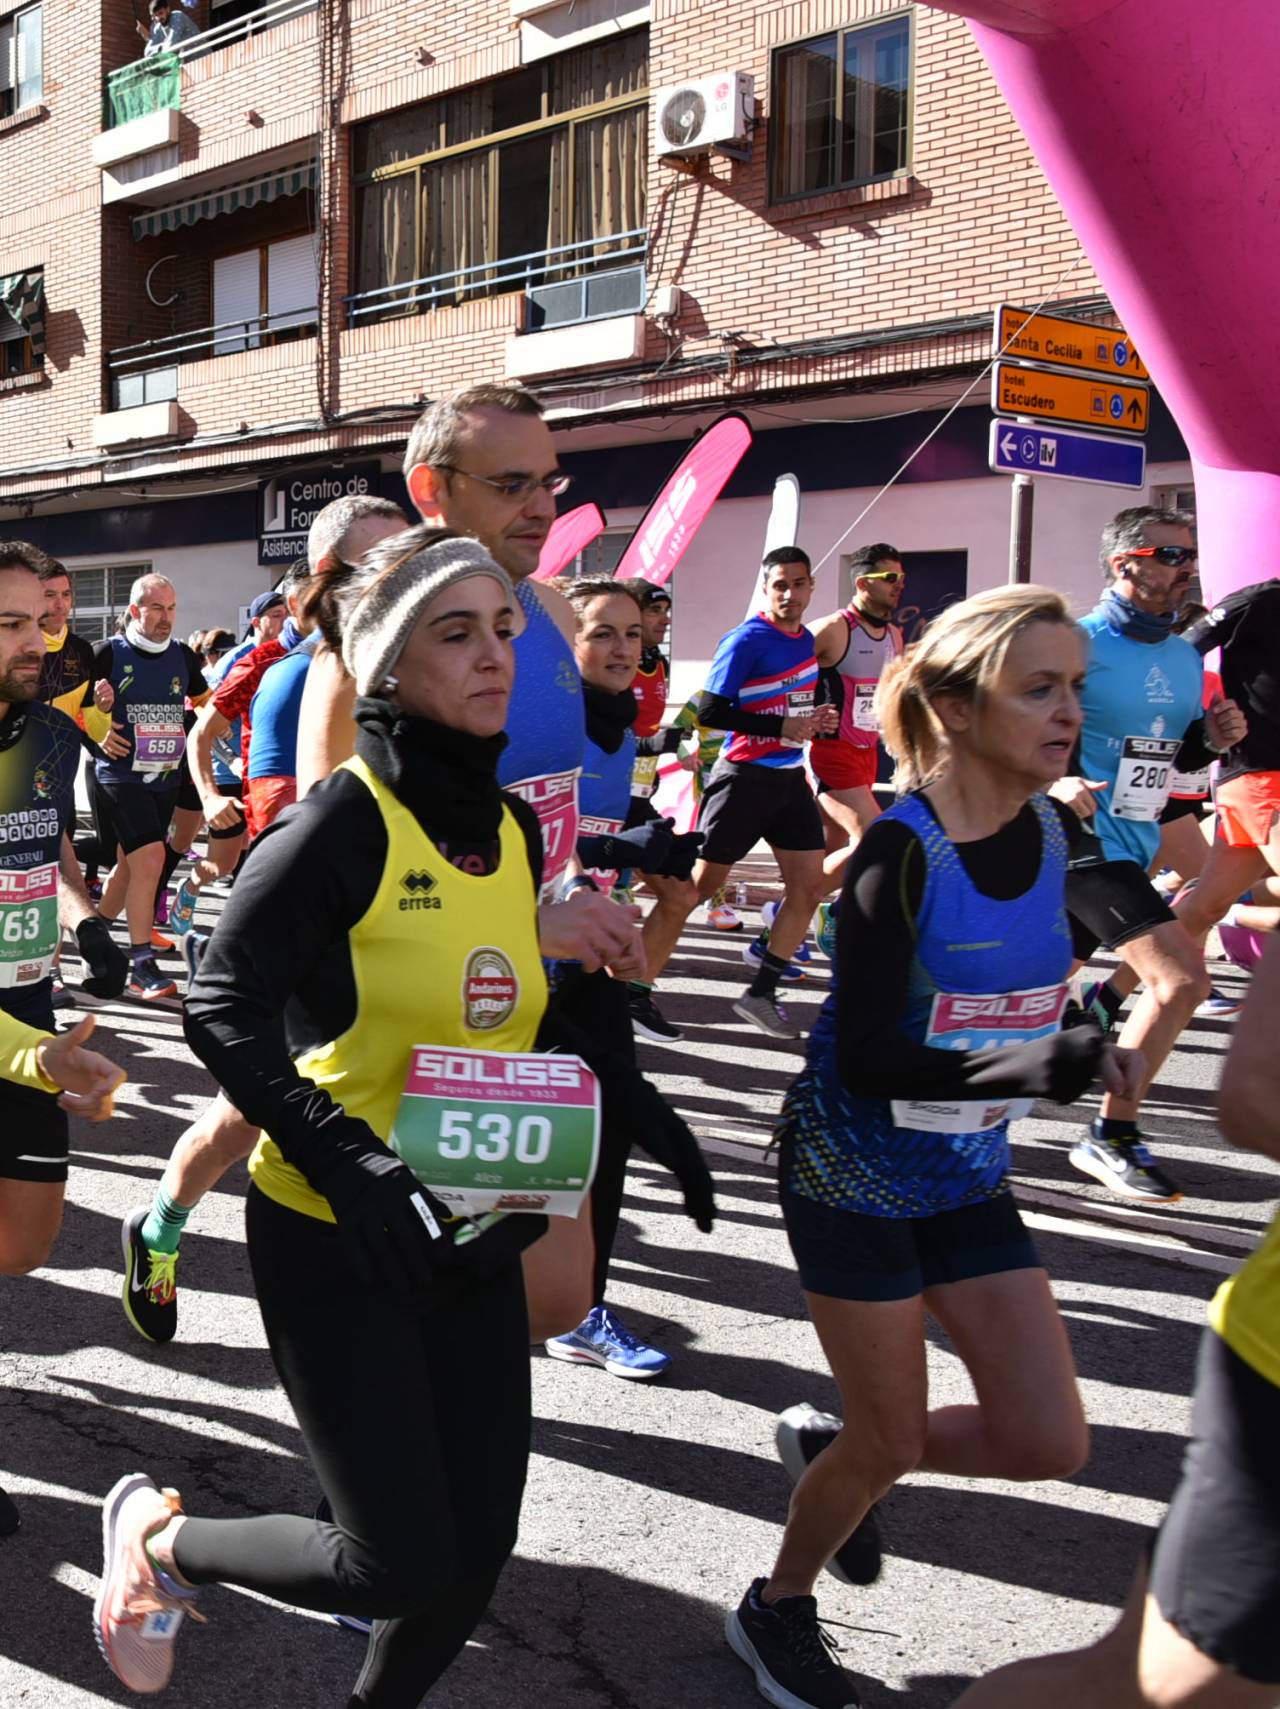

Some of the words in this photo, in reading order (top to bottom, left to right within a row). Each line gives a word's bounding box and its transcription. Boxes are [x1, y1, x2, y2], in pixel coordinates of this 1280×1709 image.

[1045, 340, 1083, 360] Cecilia
[1004, 373, 1026, 387] hotel
[1003, 389, 1056, 411] Escudero
[290, 478, 342, 502] Centro
[346, 474, 369, 496] de
[262, 536, 310, 558] Asistenci
[148, 739, 176, 754] 658
[415, 1052, 582, 1089] SOLISS
[431, 1082, 483, 1096] Seguros
[486, 1086, 525, 1097] desde
[437, 1109, 553, 1164] 530
